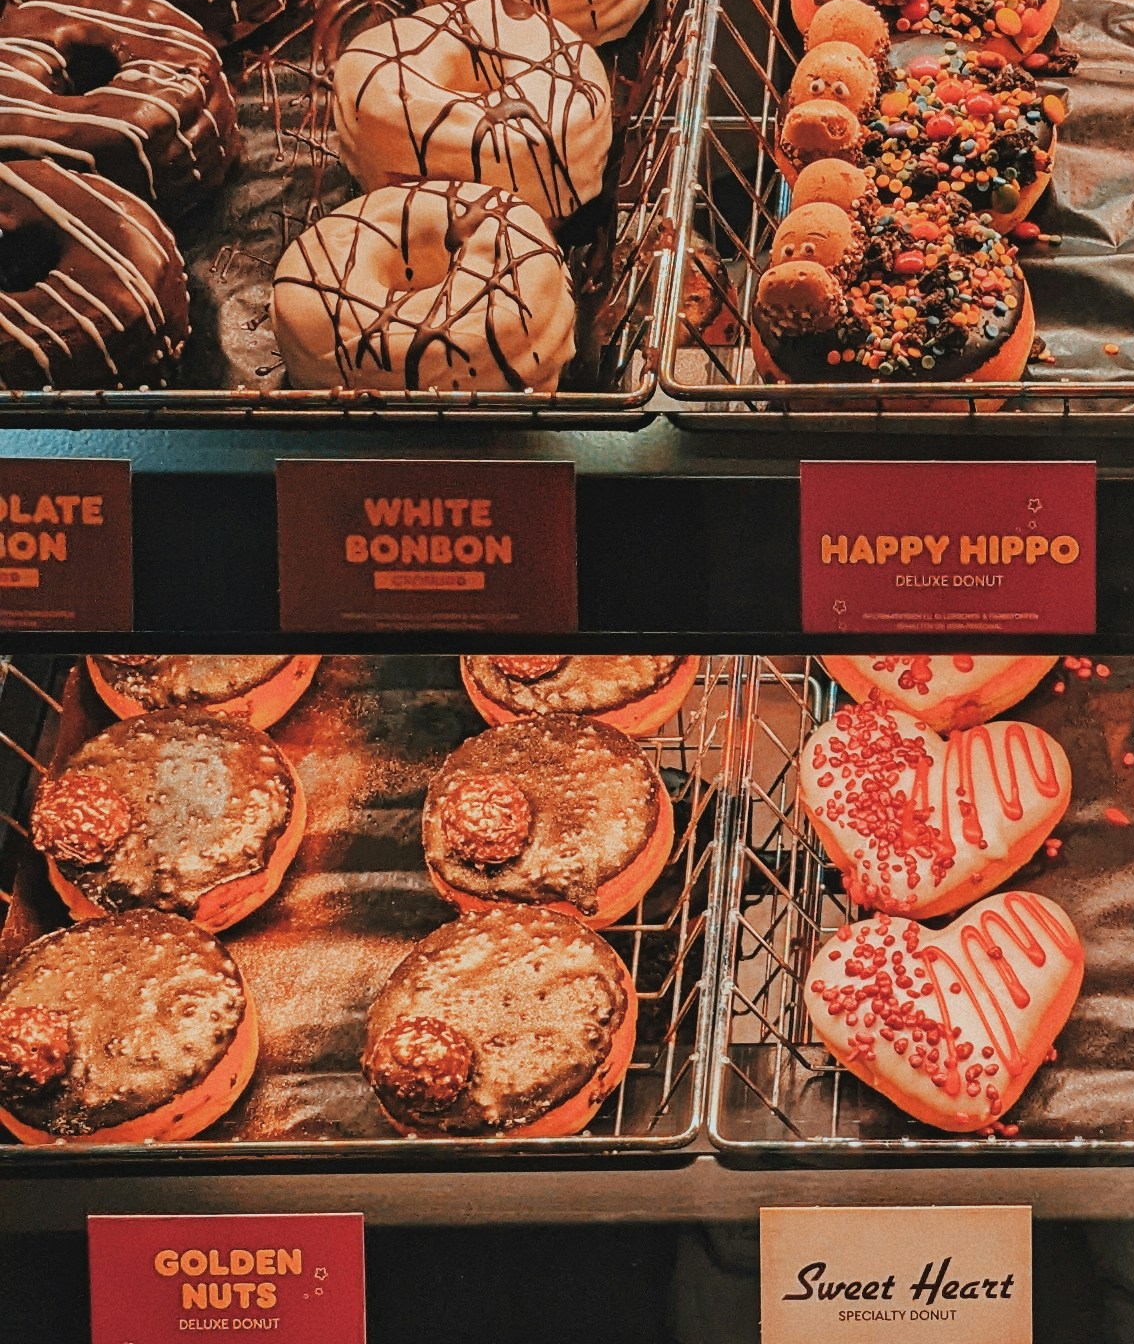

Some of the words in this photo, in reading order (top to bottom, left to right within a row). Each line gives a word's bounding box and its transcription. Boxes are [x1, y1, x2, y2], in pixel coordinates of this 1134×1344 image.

[363, 497, 493, 527] WHITE
[0, 531, 67, 561] ON
[345, 534, 513, 564] BONBON
[821, 534, 950, 565] HAPPY
[960, 535, 1080, 565] HIPPO
[895, 575, 949, 587] DELUXE
[953, 575, 1004, 587] DONUT
[154, 1248, 302, 1277] GOLDEN
[182, 1282, 277, 1309] NUTS
[781, 1261, 896, 1301] Sweet
[909, 1256, 1015, 1306] Heart
[179, 1318, 229, 1330] DELUXE
[232, 1317, 280, 1330] DONUT
[838, 1310, 906, 1322] SPECIALTY
[910, 1309, 957, 1321] DONUT
